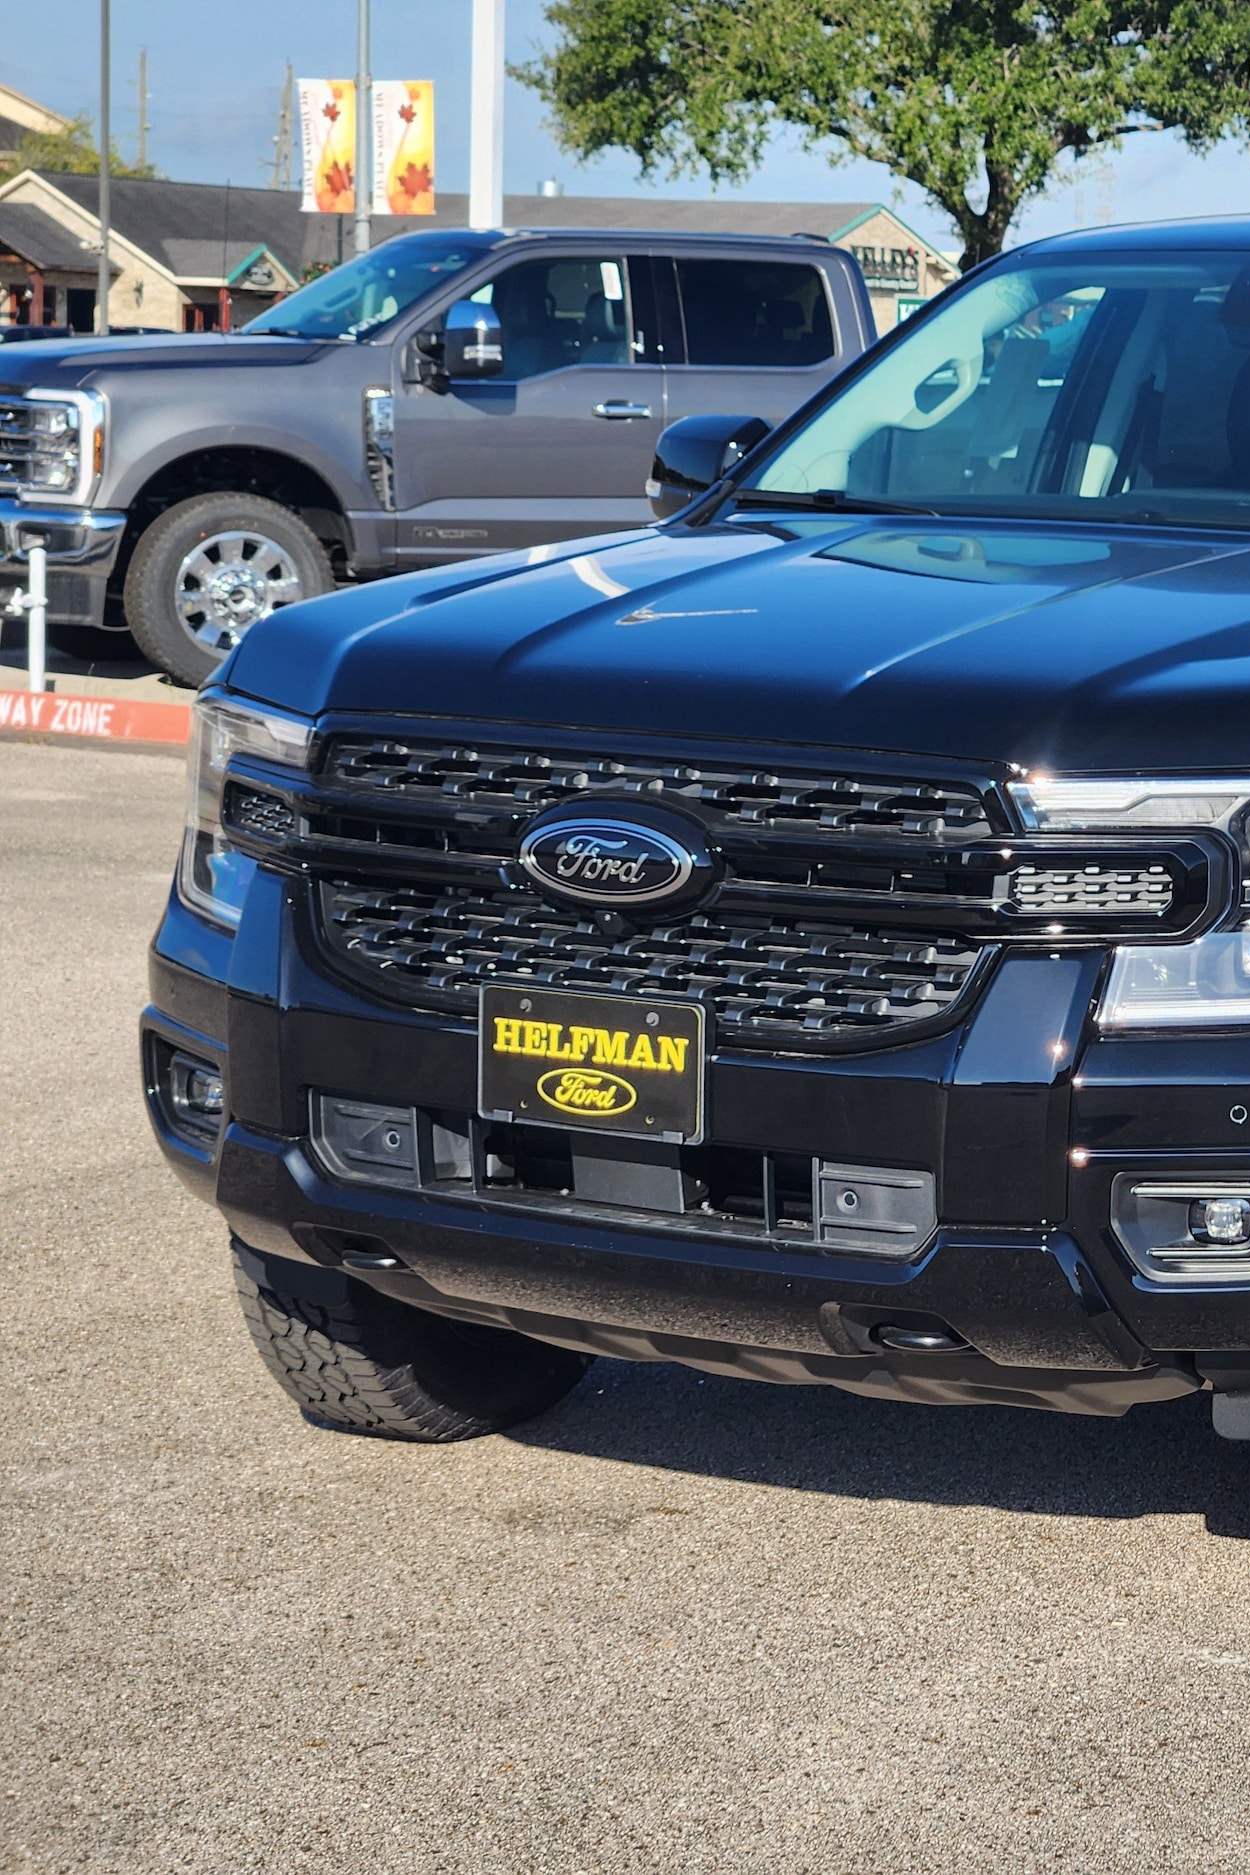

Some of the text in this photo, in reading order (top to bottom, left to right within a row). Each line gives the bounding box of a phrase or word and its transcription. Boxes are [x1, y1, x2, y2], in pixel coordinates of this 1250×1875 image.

[51, 699, 115, 737] ZONE
[556, 834, 650, 884] Ford
[493, 1017, 690, 1073] HELFMAN
[555, 1072, 618, 1110] Ford
